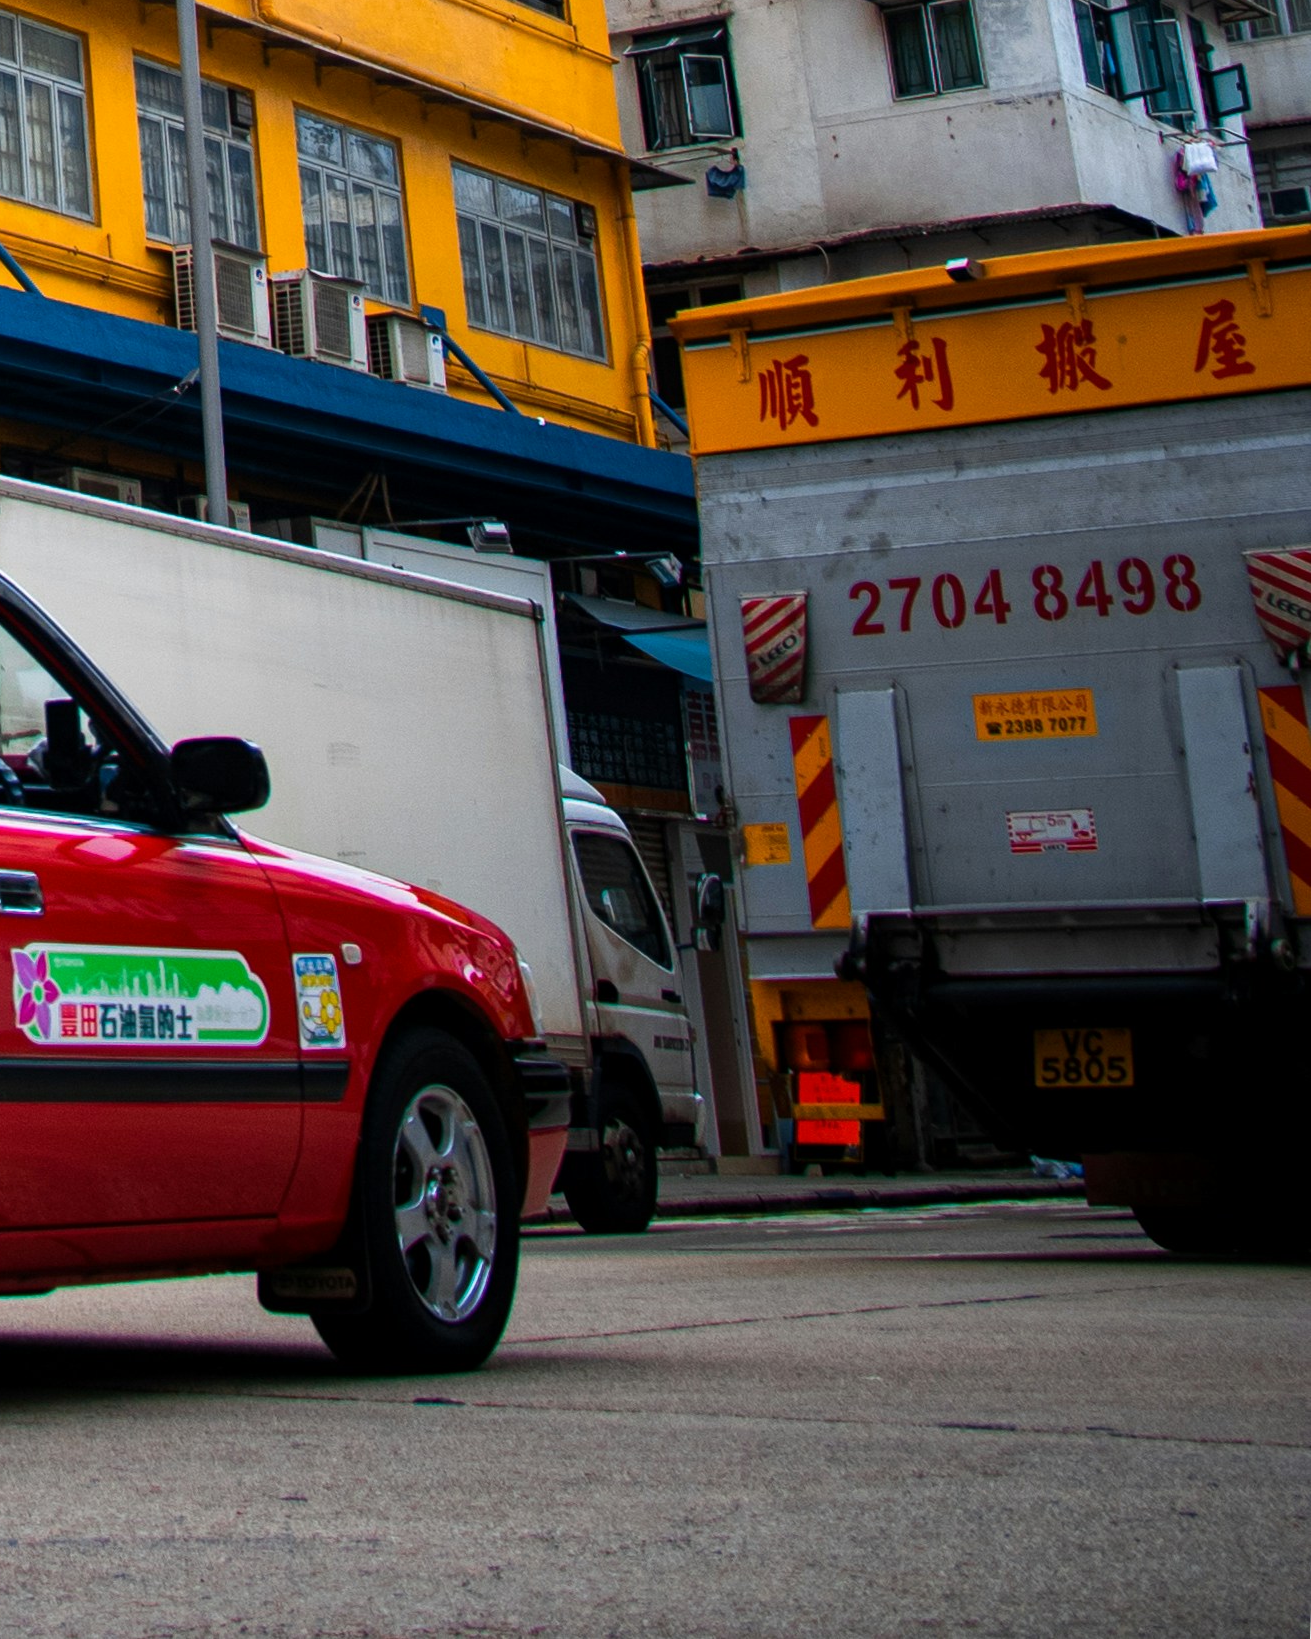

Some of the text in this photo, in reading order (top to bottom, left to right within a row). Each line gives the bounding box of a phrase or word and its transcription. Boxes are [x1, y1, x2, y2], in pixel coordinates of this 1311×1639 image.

[759, 299, 1257, 431] 順利搬屋
[849, 553, 1203, 636] 2704 8498
[1005, 716, 1087, 734] 2388 7077
[1061, 1030, 1103, 1056] VC
[1042, 1056, 1126, 1083] 5805
